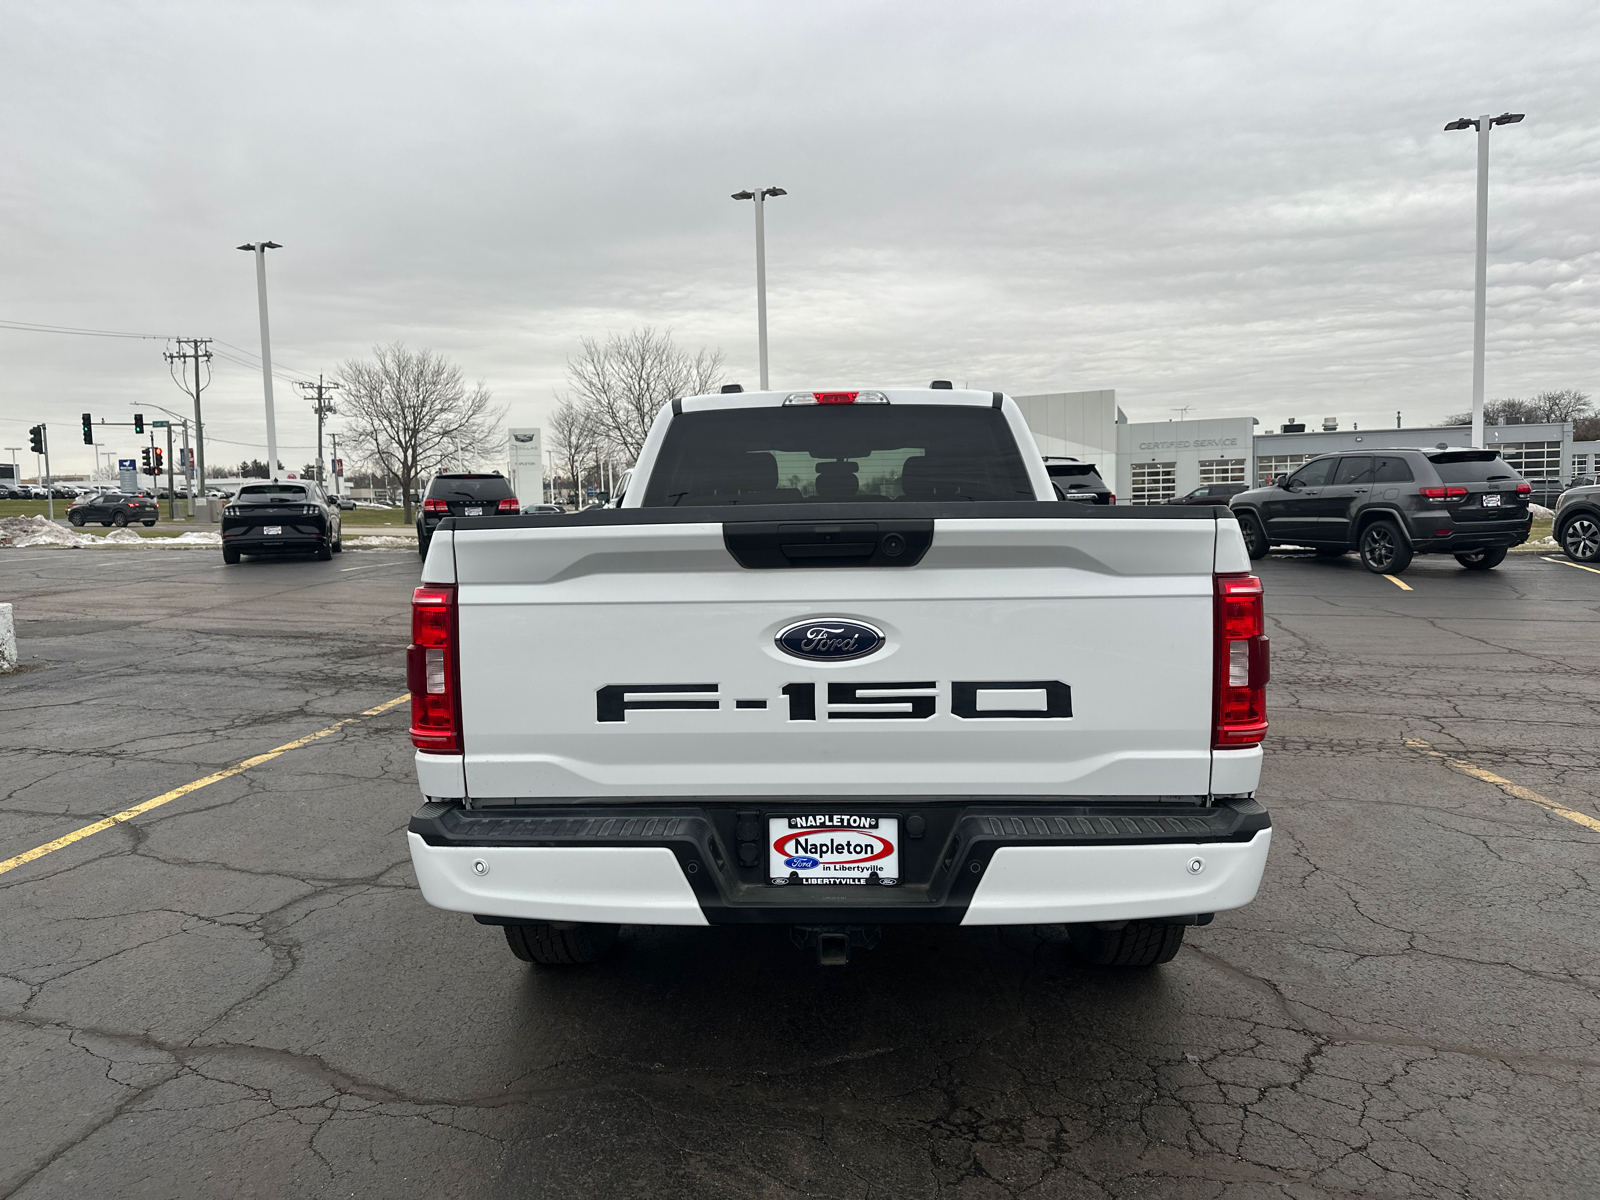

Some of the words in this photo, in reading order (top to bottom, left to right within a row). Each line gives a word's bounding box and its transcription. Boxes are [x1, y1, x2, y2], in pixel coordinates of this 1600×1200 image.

[1139, 441, 1191, 450] CERTIFIED
[1193, 438, 1238, 447] SERVICE
[801, 627, 859, 651] Ford
[596, 681, 1073, 721] F-150
[796, 815, 870, 828] NAPLETON
[795, 838, 874, 858] Napleton
[791, 858, 813, 868] Ford
[833, 865, 884, 873] Libertyville
